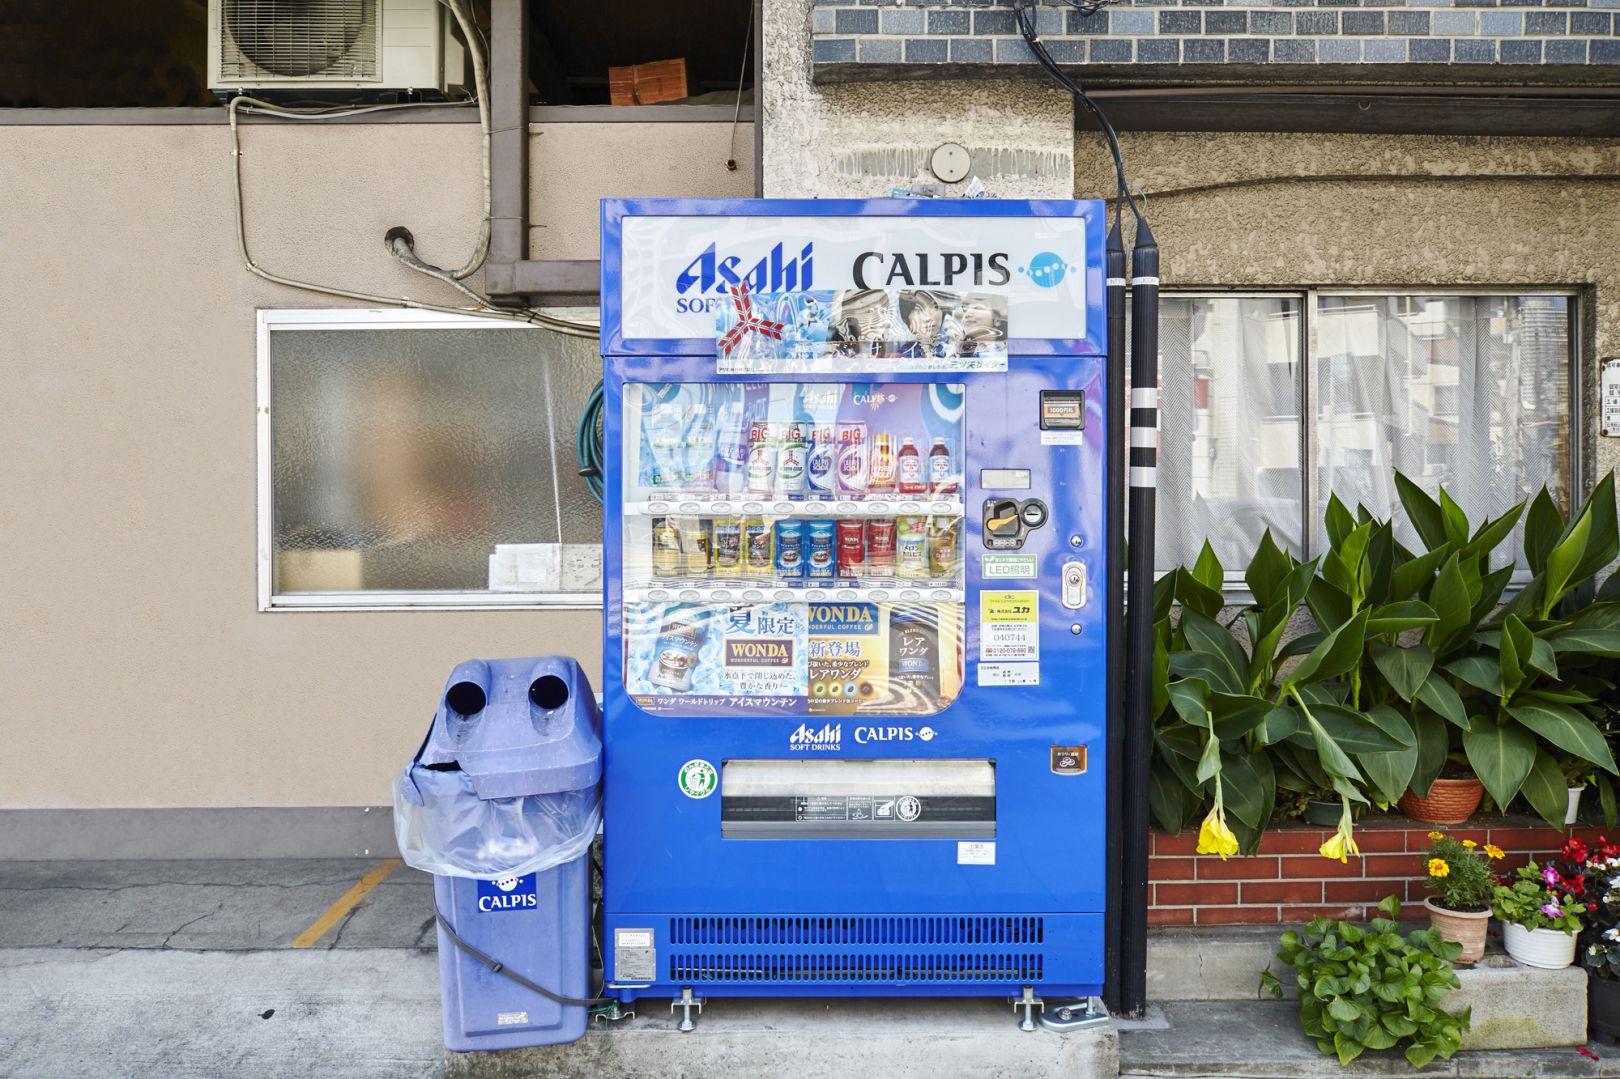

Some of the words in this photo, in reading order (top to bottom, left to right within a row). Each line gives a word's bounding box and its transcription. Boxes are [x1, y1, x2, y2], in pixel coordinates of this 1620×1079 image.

[676, 242, 813, 294] Asahi
[852, 251, 1012, 289] CALPIS
[677, 298, 715, 313] SOF
[751, 428, 769, 440] BIG
[781, 428, 801, 440] BIG
[812, 428, 831, 440] BIG
[842, 428, 861, 440] BIG
[989, 565, 1031, 575] LED照明
[903, 637, 925, 647] レア
[731, 643, 789, 657] WONDA
[811, 641, 861, 657] 新登場
[899, 647, 929, 656] ワンダ
[809, 669, 862, 680] レアワンダ
[740, 682, 778, 690] 豊かな香り
[657, 697, 676, 705] ワンダ
[679, 698, 726, 706] ワールドトリップ
[729, 697, 798, 707] アイスマウンテン
[790, 723, 841, 743] Asahi
[854, 726, 914, 744] CALPIS
[478, 893, 537, 912] CALPIS
